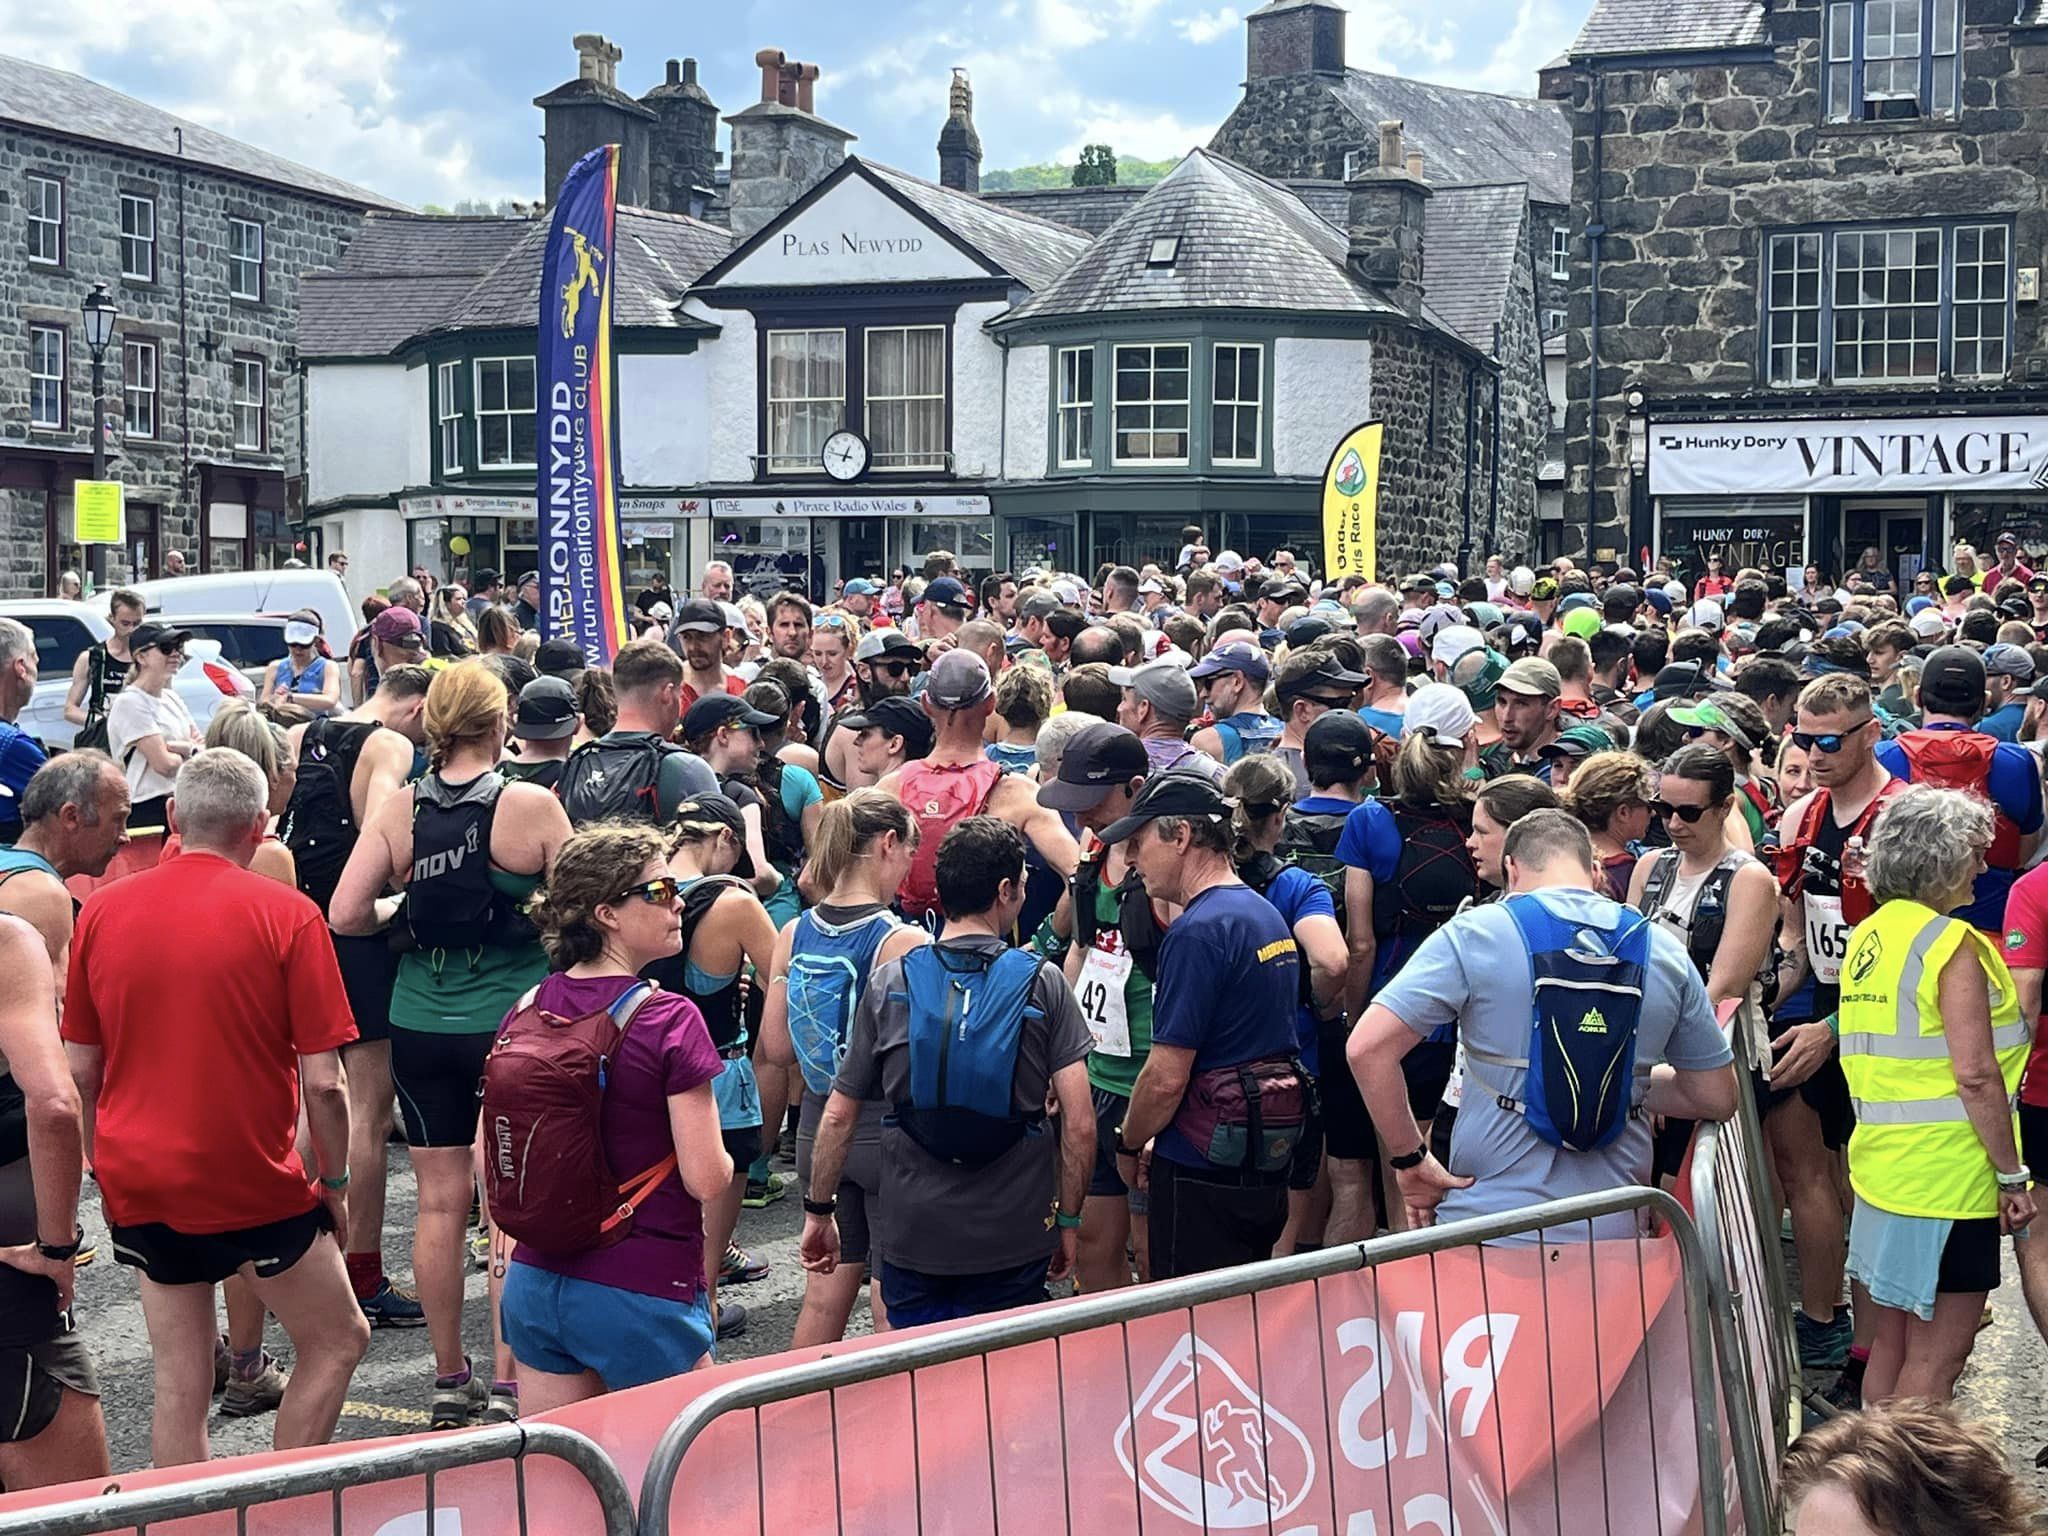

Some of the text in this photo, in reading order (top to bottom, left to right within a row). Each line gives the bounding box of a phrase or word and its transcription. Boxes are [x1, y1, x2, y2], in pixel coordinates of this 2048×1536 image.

[574, 344, 588, 409] CLUB
[1686, 432, 2031, 478] Hunky Dory VINTAGE
[632, 498, 665, 511] Snaps
[793, 500, 907, 512] Pirate Radio Wales
[1350, 503, 1361, 543] Race
[1693, 529, 1770, 541] HUNKY DORY
[1810, 920, 1849, 959] 165
[1081, 980, 1107, 1024] 42
[495, 1115, 516, 1179] CAMELBAK
